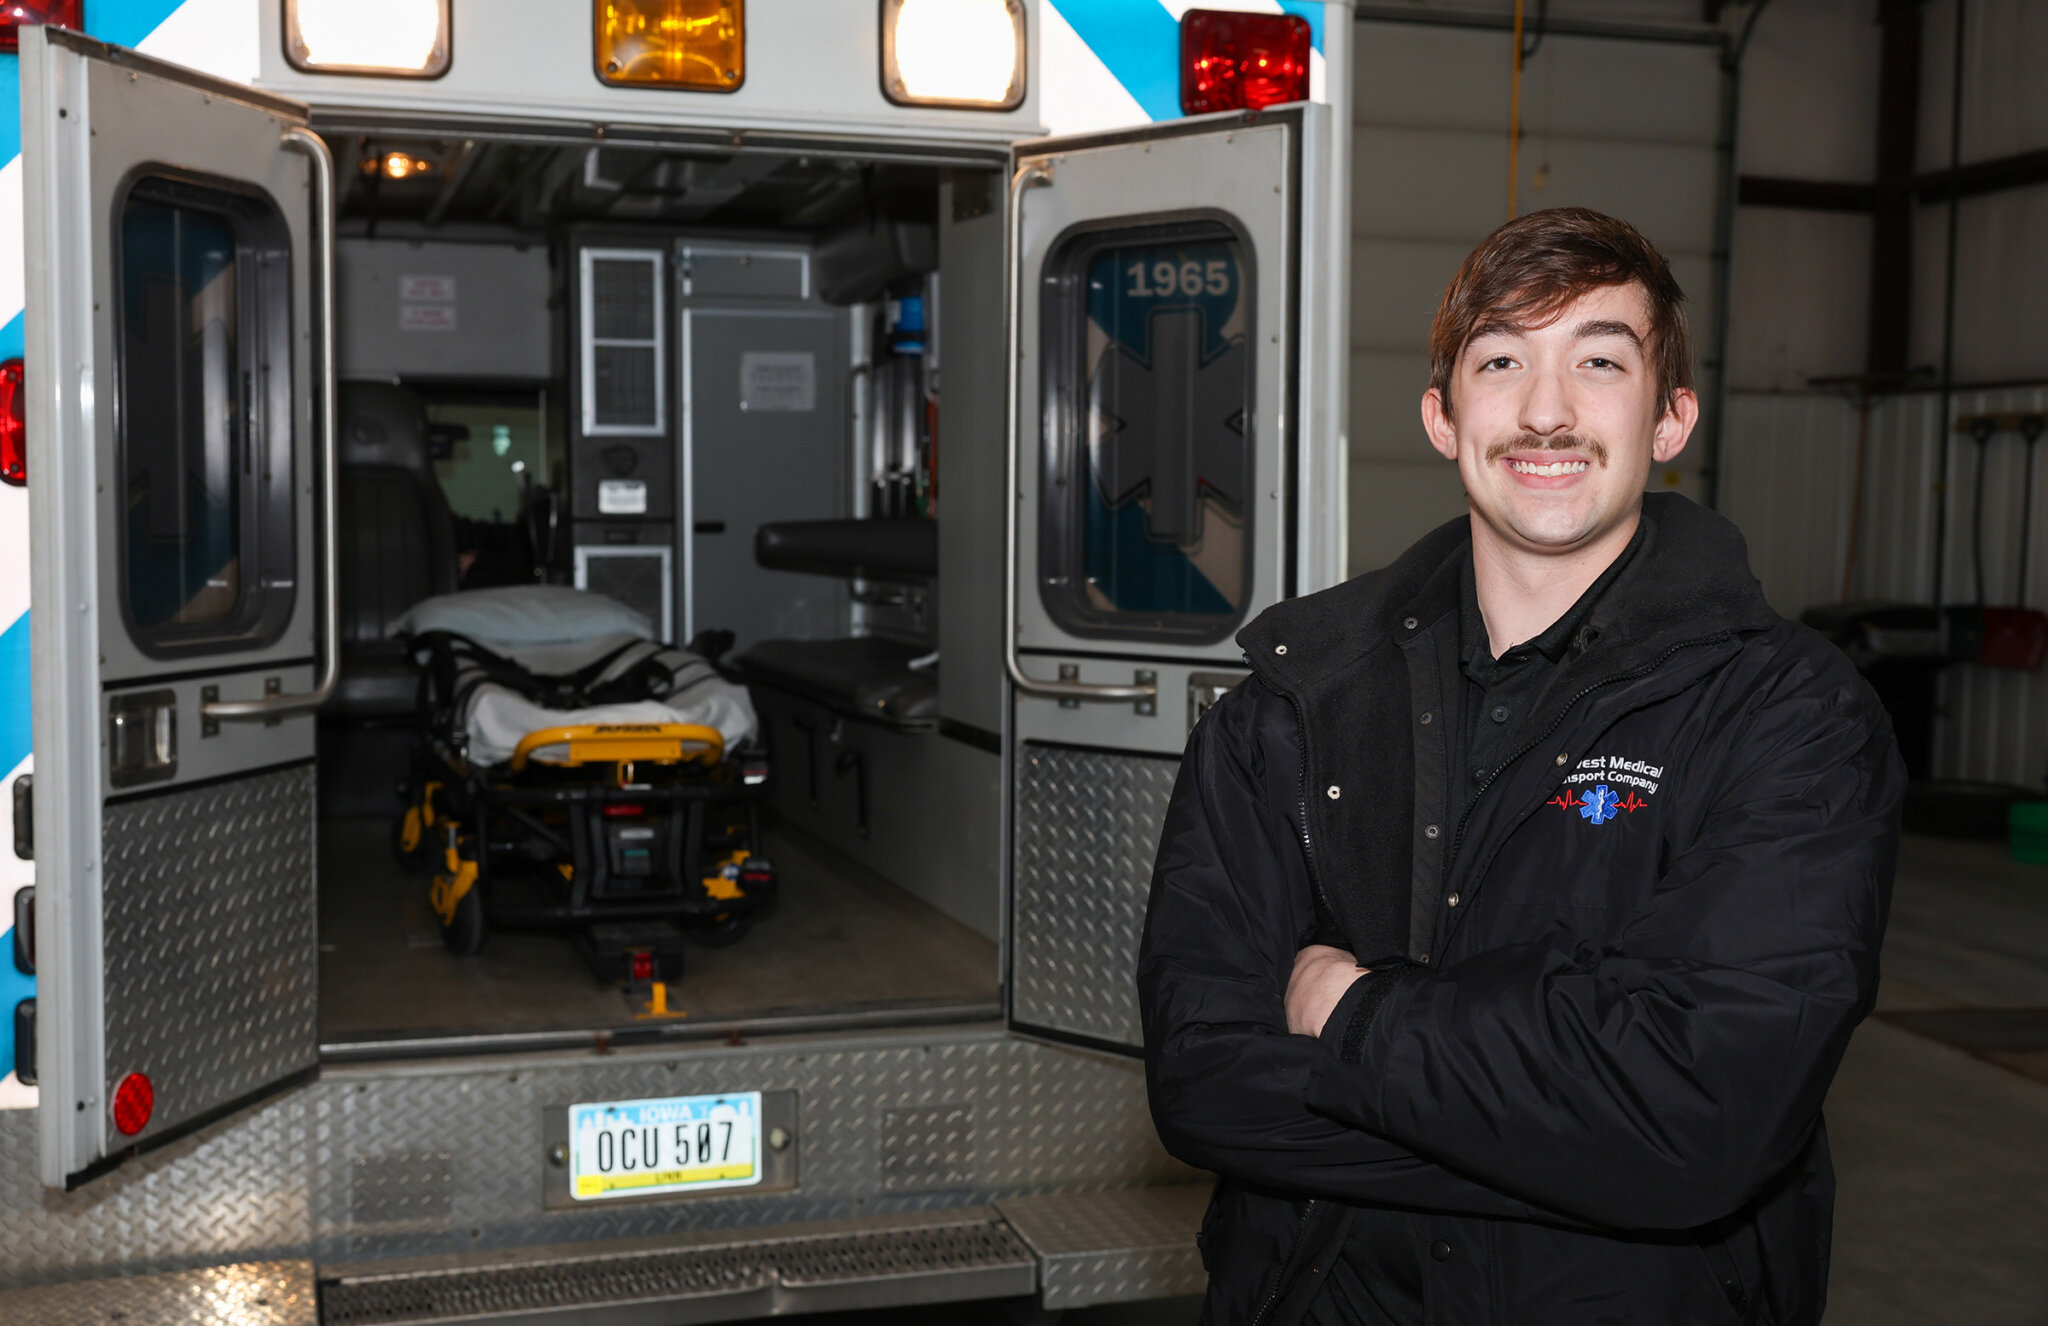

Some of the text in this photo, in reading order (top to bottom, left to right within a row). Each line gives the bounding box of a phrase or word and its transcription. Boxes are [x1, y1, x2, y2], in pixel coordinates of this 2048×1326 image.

[1127, 261, 1230, 296] 1965
[1609, 756, 1664, 778] Medical
[1607, 771, 1659, 795] Company
[639, 1104, 693, 1122] IOWA
[598, 1121, 733, 1172] OCU 507
